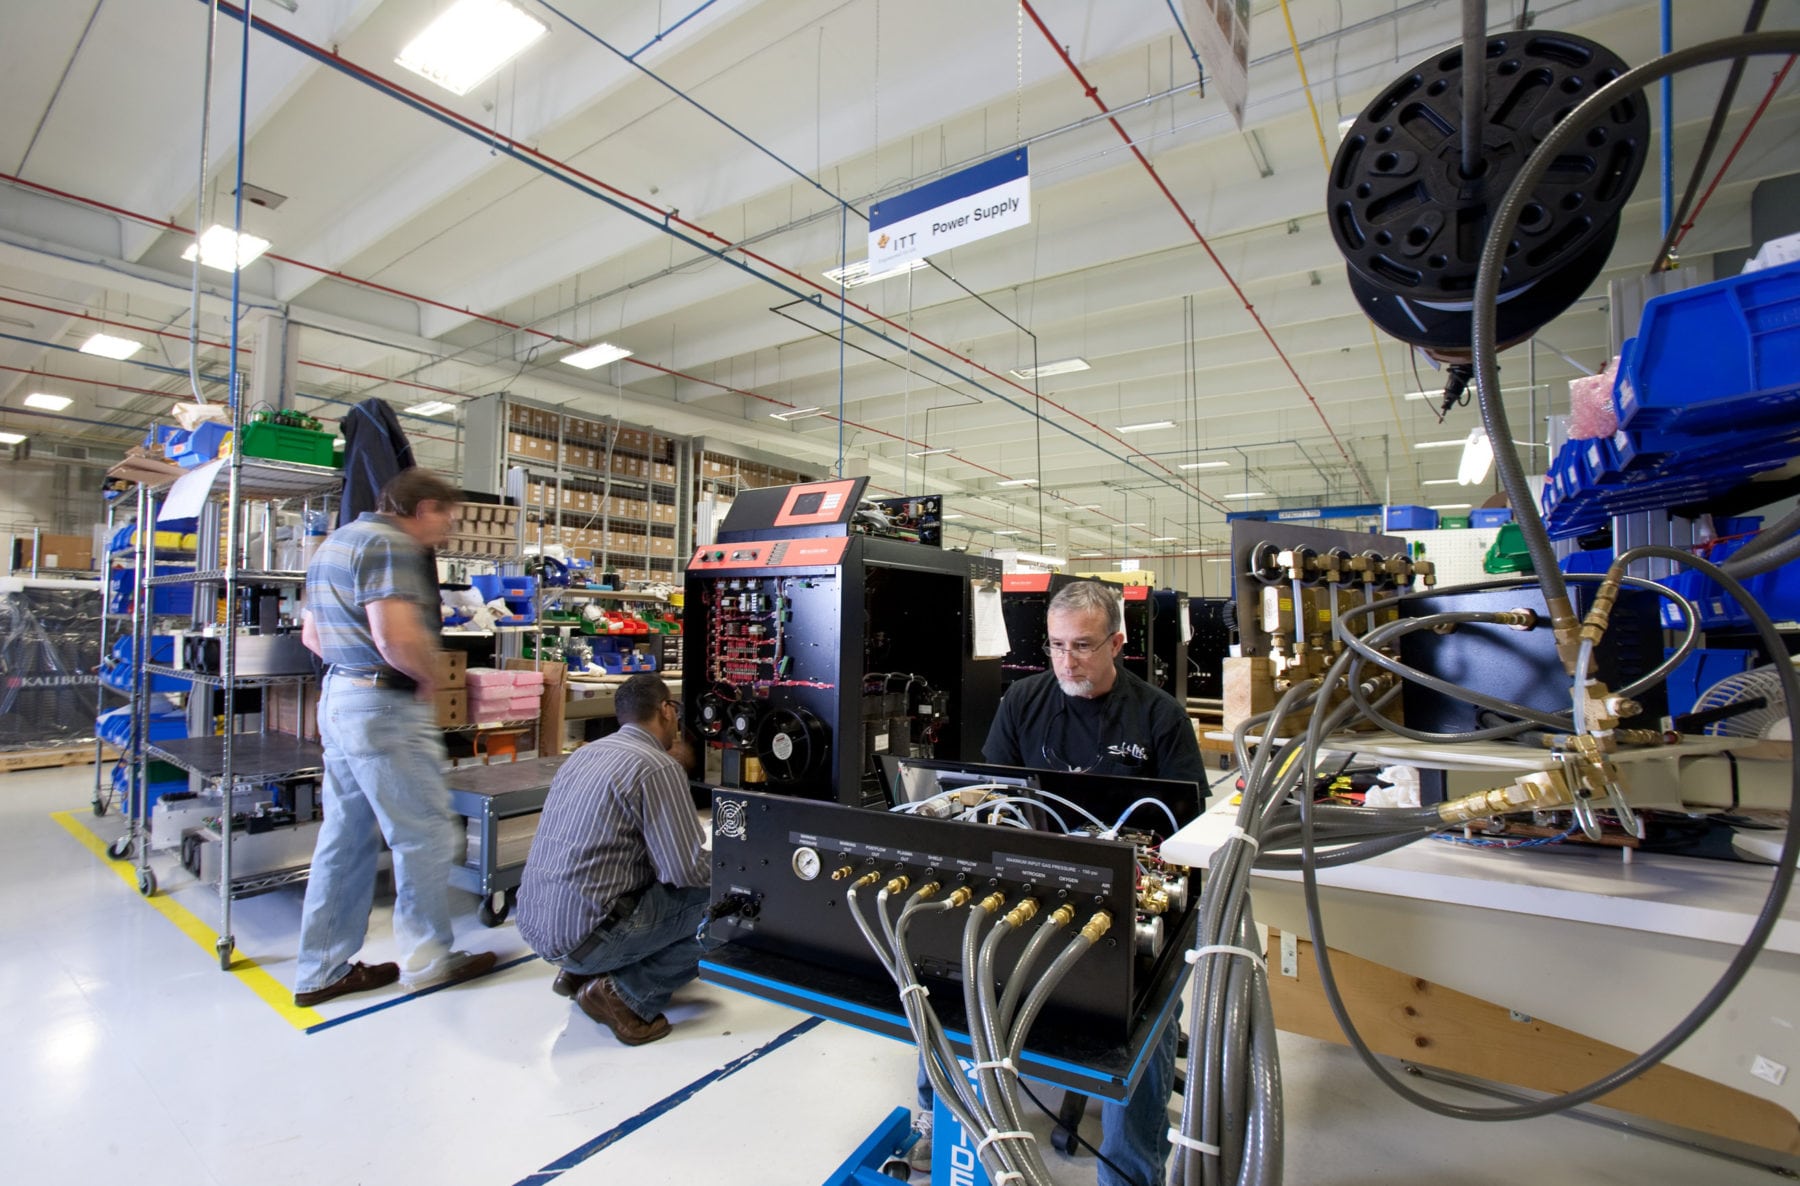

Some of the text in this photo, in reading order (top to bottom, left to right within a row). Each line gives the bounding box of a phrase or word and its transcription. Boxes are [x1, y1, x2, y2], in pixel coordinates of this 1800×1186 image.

[932, 197, 1020, 236] Power Supply
[894, 232, 917, 251] ITT
[956, 859, 977, 867] PREFLOW
[1006, 857, 1027, 865] MAXIMUM
[1052, 864, 1077, 873] PRESSURE
[1021, 870, 1046, 878] NITROGEN
[1058, 876, 1079, 884] OXYGEN
